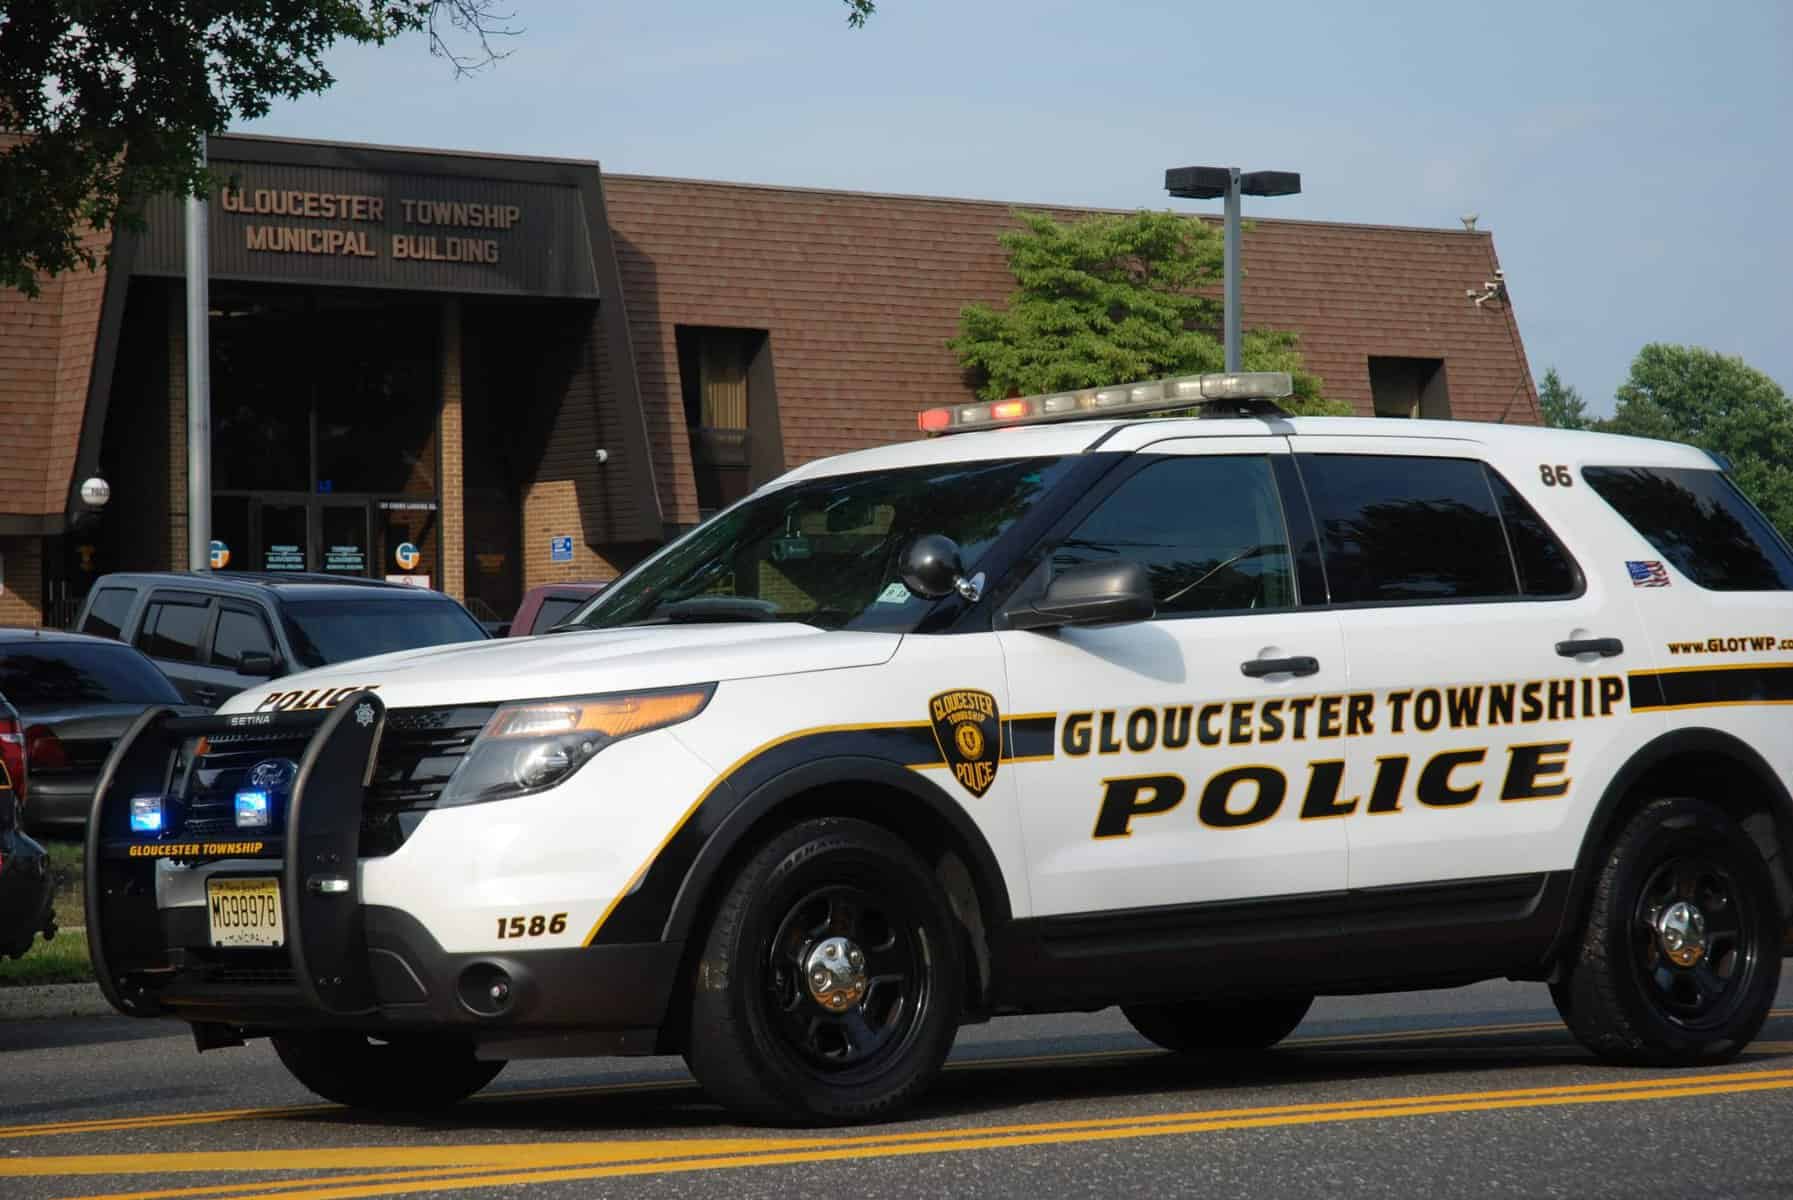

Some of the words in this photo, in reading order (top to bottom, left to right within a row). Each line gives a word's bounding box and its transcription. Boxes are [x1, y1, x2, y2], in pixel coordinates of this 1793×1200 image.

[222, 187, 383, 220] GLOUCESTER
[401, 199, 519, 228] TOWNSHIP
[246, 225, 376, 256] MUNICIPAL
[392, 234, 498, 263] BUILDING
[1539, 464, 1572, 487] 86
[255, 684, 382, 712] POLIC
[933, 692, 994, 720] GLOUCESTER
[231, 715, 271, 727] SETINA
[1061, 693, 1374, 758] GLOUCESTER
[1387, 675, 1626, 734] TOWNSHIP
[251, 763, 283, 786] Ford
[956, 762, 993, 792] POLICE
[1091, 741, 1573, 842] POLICE
[129, 844, 200, 857] GLOUCESTER
[203, 842, 264, 855] TOWNSHIP
[211, 895, 276, 929] MG98978
[497, 912, 569, 939] 1586
